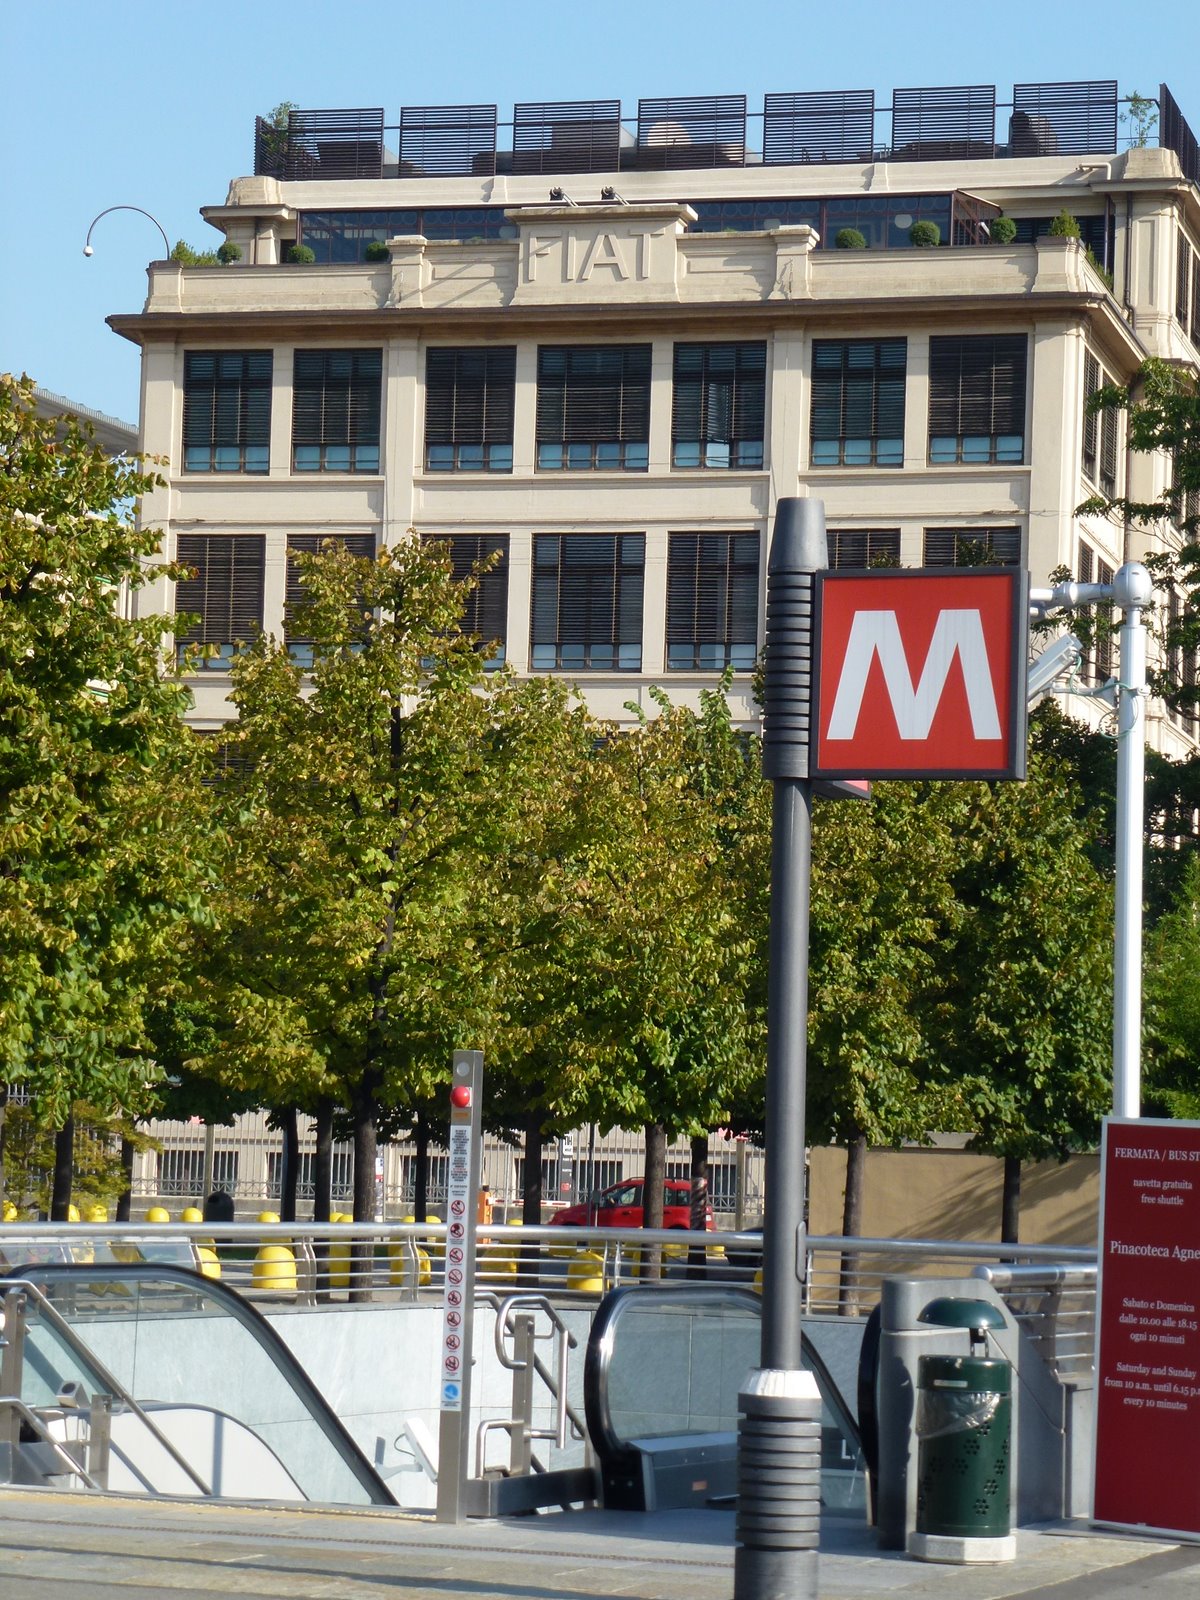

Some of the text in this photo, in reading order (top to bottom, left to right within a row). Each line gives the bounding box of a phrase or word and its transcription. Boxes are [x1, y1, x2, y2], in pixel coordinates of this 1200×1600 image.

[528, 227, 666, 282] FIAT
[826, 608, 1003, 740] M
[1114, 1147, 1160, 1160] FERMATA
[1168, 1150, 1188, 1161] BUS
[1133, 1178, 1193, 1190] navetta gratuita
[1141, 1193, 1184, 1205] free shuttle
[1110, 1240, 1170, 1258] Pinacoteca
[1122, 1297, 1149, 1309] Sabato
[1156, 1300, 1195, 1312] Domenica
[1119, 1313, 1198, 1331] dalle 10.00 alle 18.15
[1130, 1331, 1185, 1345] ogni 10 minuti
[1116, 1362, 1197, 1380] Saturday and Sunday
[1104, 1376, 1123, 1387] from
[1124, 1380, 1134, 1389] 10
[1135, 1382, 1152, 1391] a.m.
[1153, 1382, 1172, 1393] until
[1173, 1384, 1190, 1396] 6.15
[1123, 1397, 1188, 1411] every 10 minutes
